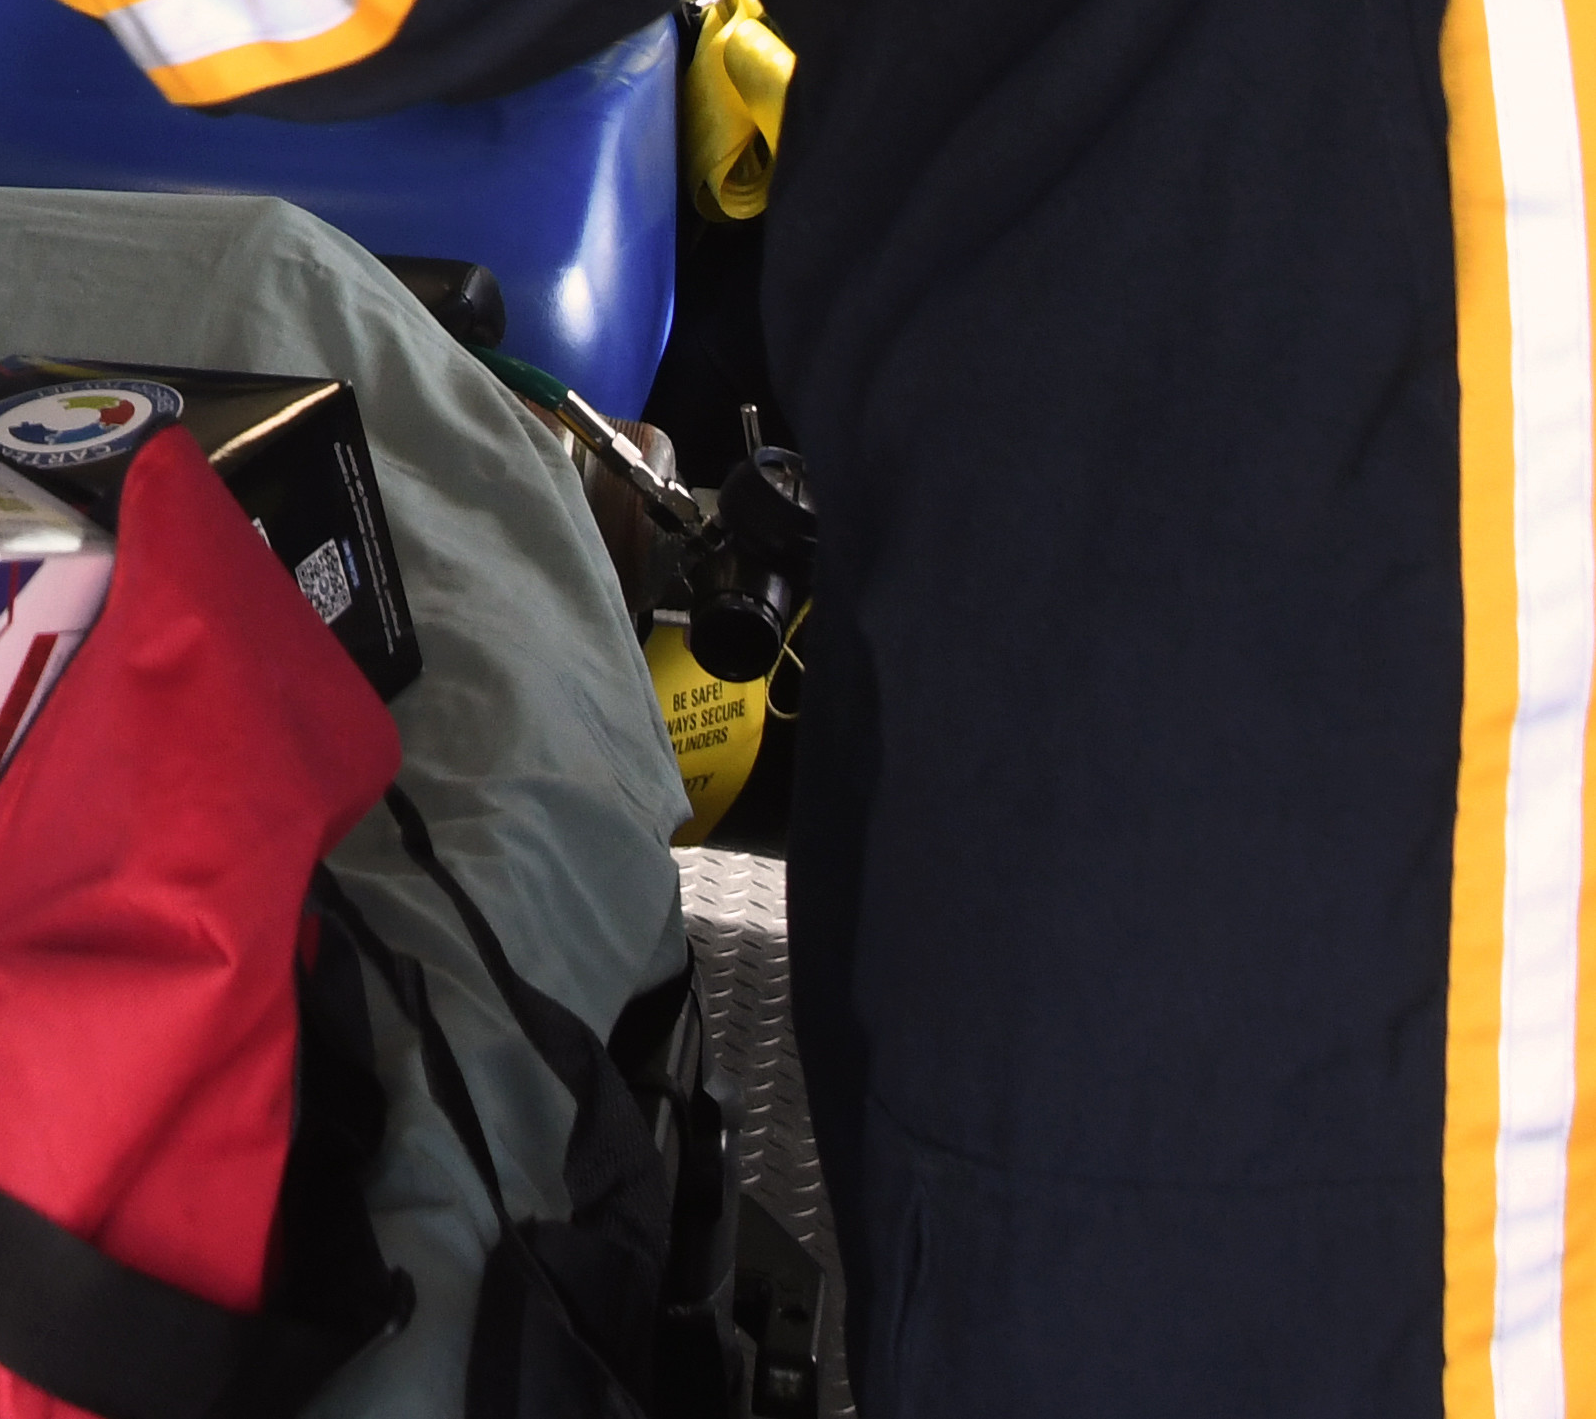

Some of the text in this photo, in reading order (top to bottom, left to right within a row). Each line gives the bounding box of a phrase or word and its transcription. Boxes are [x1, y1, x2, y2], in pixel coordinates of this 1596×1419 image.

[672, 680, 724, 713] BE SAFE!
[666, 697, 746, 737] WAYS SECURE
[672, 725, 729, 756] YLINDERS
